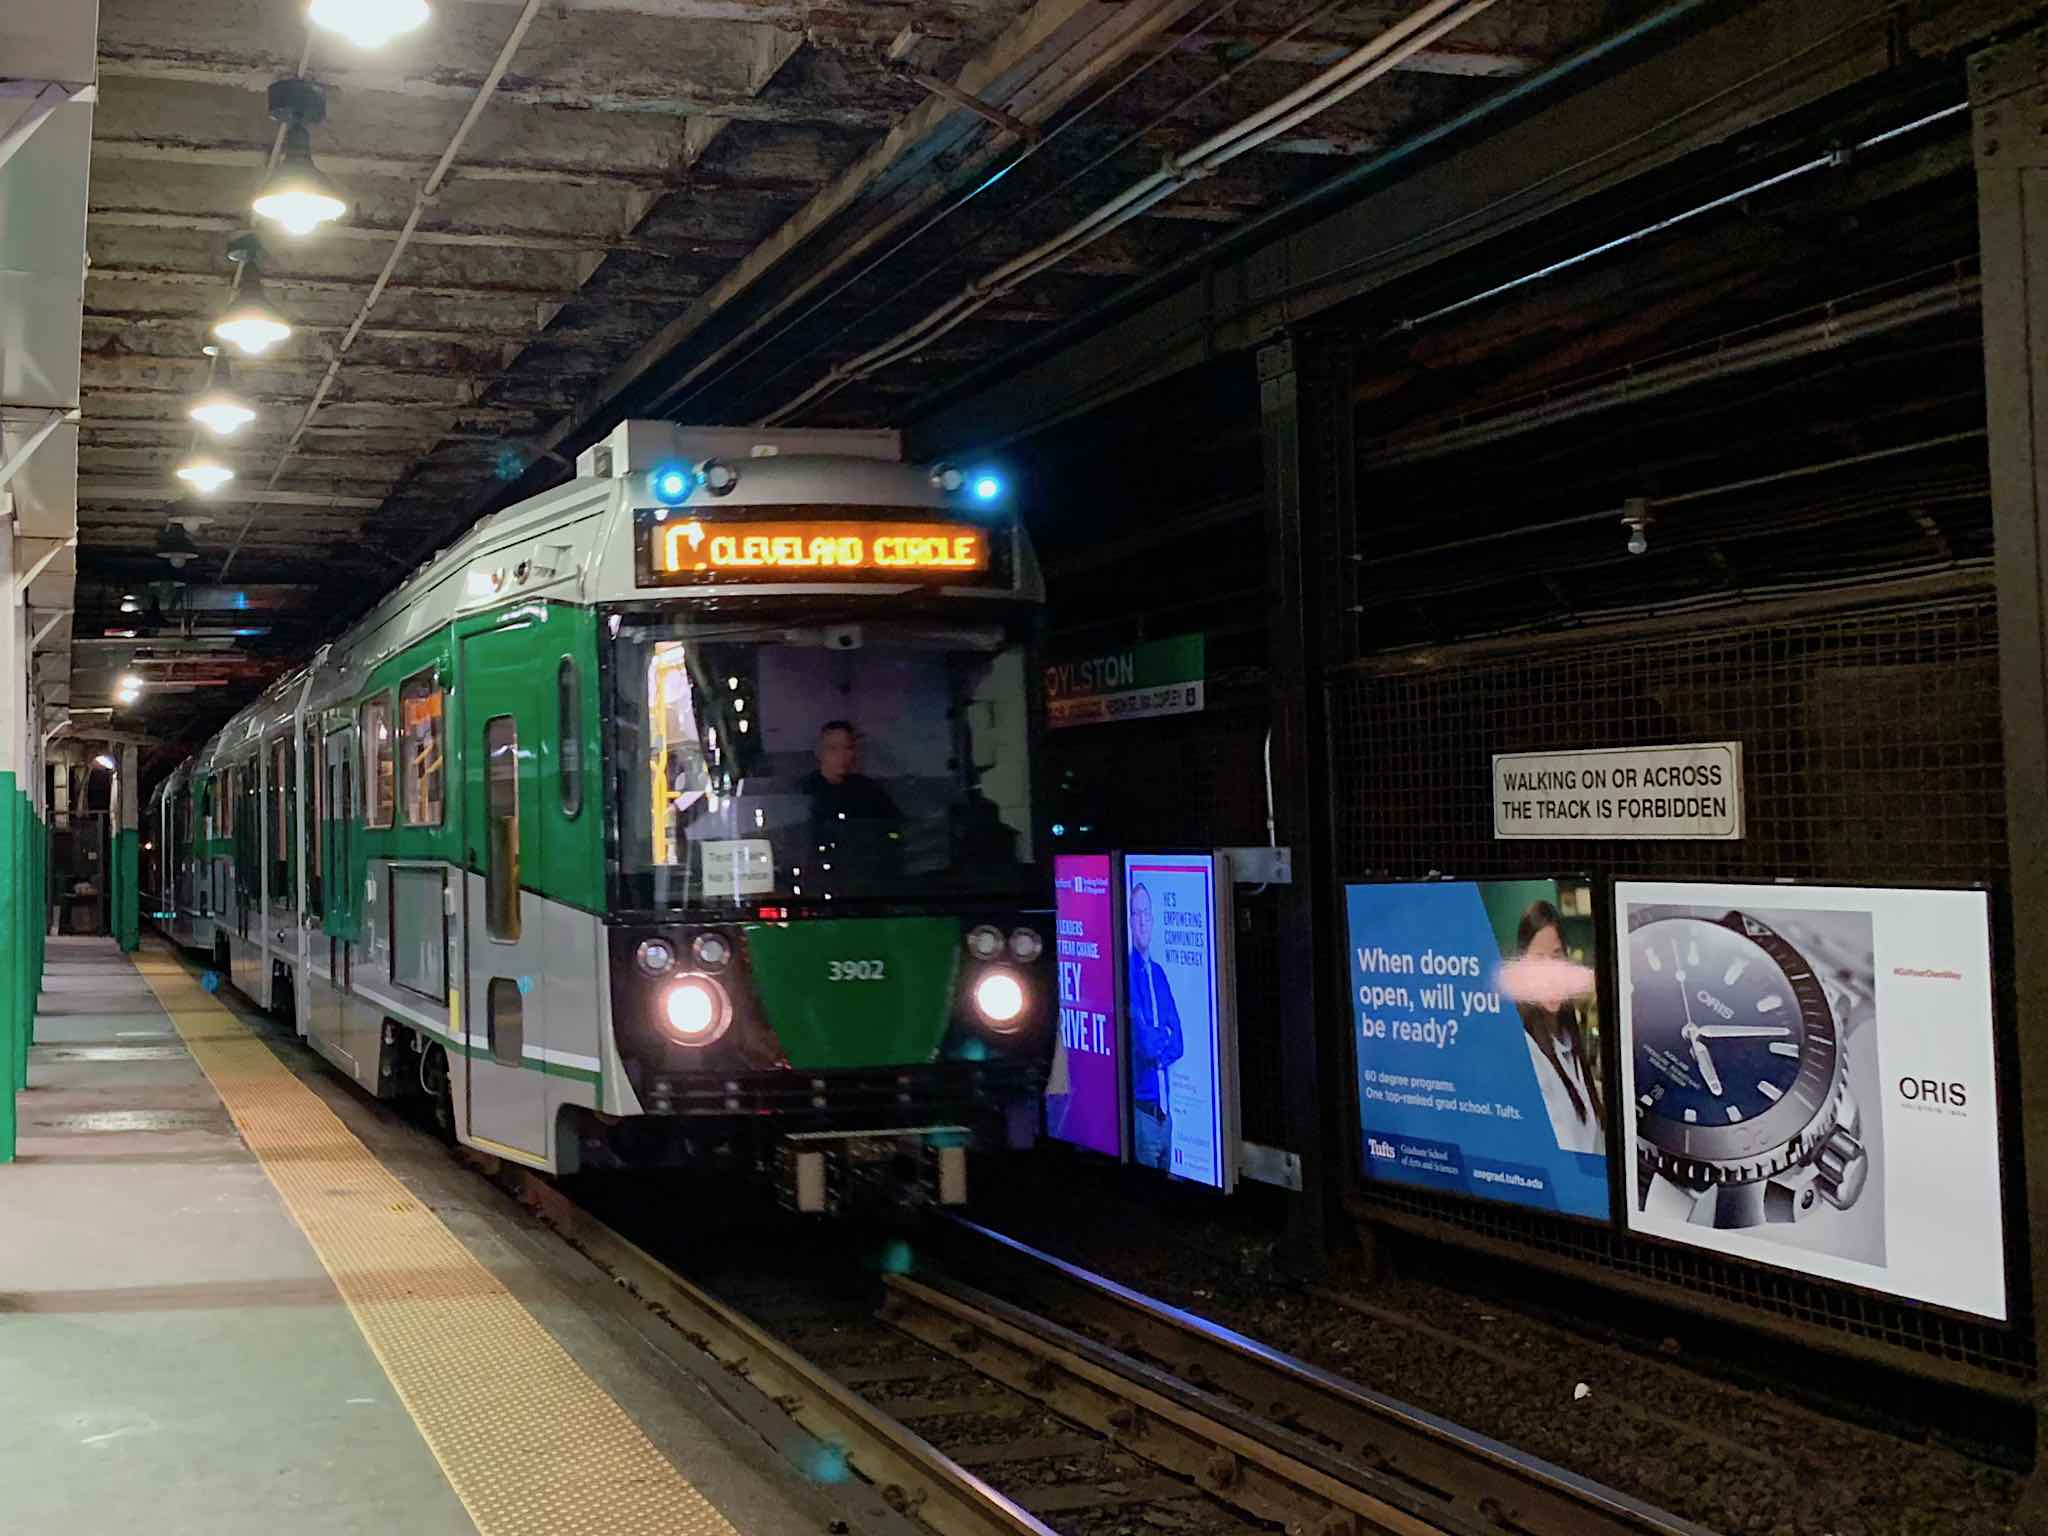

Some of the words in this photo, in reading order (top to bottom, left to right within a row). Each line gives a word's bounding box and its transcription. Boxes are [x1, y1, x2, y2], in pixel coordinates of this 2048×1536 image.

[709, 536, 864, 564] CLEVELAND
[872, 536, 977, 564] CIRCLE
[1503, 769, 1577, 791] WALKING
[1581, 769, 1606, 789] ON
[1612, 768, 1638, 788] OR
[1643, 765, 1722, 787] ACROSS
[1502, 801, 1532, 819] THE
[1536, 800, 1591, 819] TRACK
[1596, 799, 1612, 818] IS
[1617, 797, 1727, 818] FORBIDDEN
[828, 960, 887, 981] 3902
[1357, 947, 1414, 973] When
[1420, 949, 1480, 976] doors
[1359, 985, 1414, 1012] open,
[1420, 984, 1455, 1010] will
[1461, 991, 1500, 1016] you
[1697, 990, 1735, 1019] ORIS
[1092, 1013, 1110, 1056] IT.
[1362, 1012, 1386, 1038] be
[1392, 1018, 1458, 1048] ready?
[1378, 1072, 1409, 1087] degree
[1900, 1077, 1967, 1106] ORIS
[1365, 1087, 1384, 1100] One
[1385, 1089, 1433, 1107] top-ranked
[1435, 1098, 1457, 1111] grad
[1459, 1100, 1492, 1115] school.
[1495, 1104, 1525, 1120] Tufts.
[1367, 1138, 1396, 1159] Tufts
[1428, 1147, 1449, 1161] School
